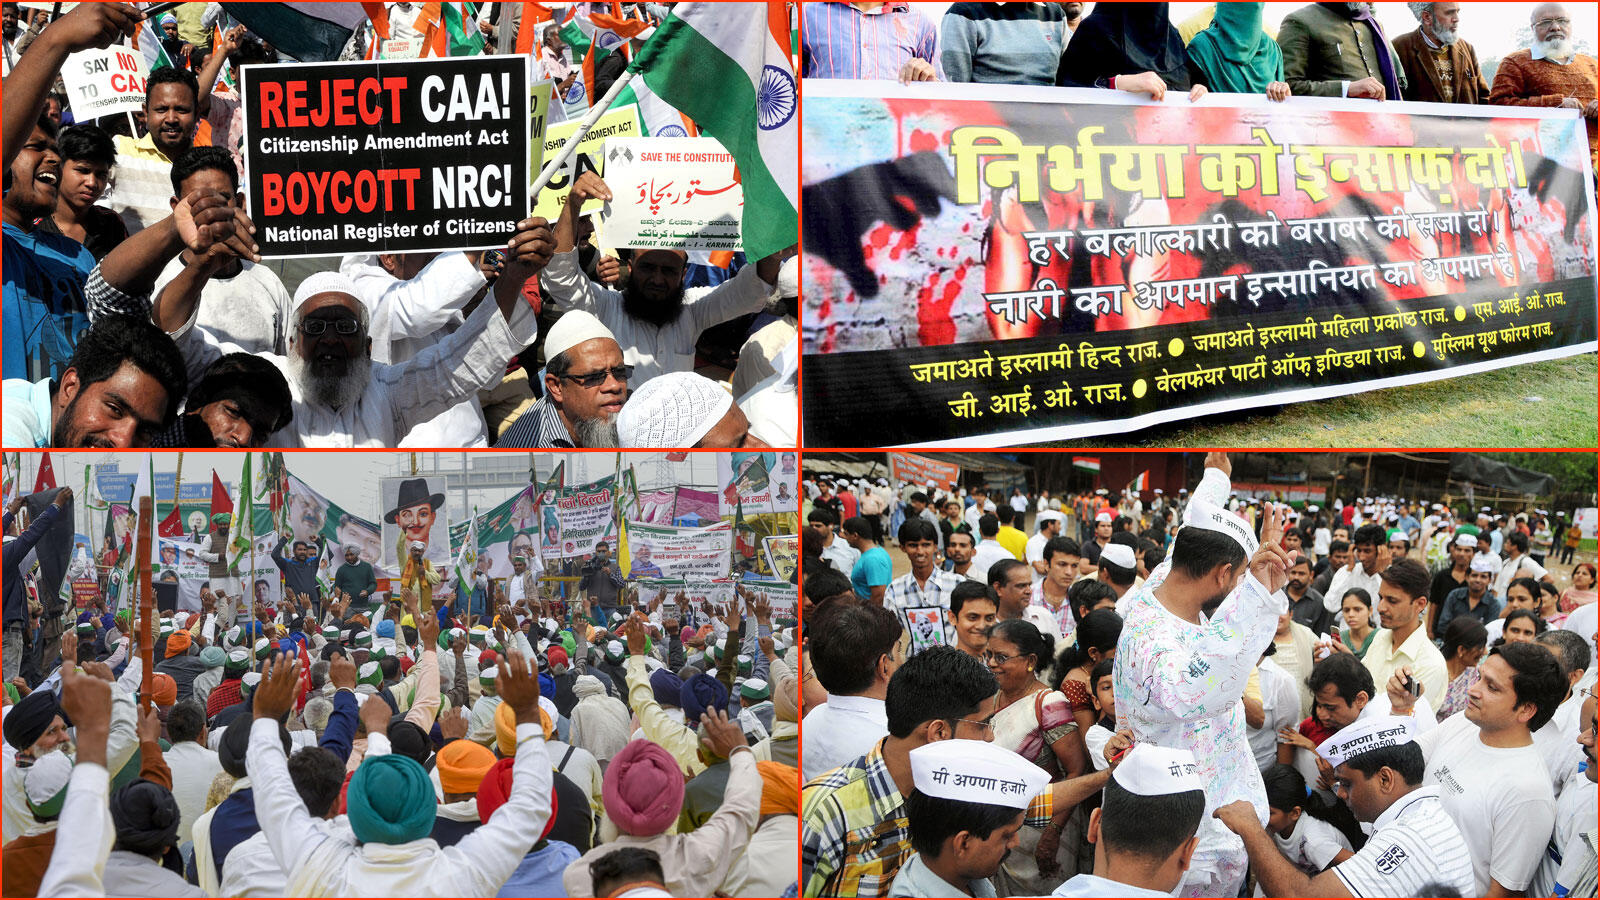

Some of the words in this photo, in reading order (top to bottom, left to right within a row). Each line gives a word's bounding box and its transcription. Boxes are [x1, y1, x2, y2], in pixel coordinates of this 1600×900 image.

[83, 57, 109, 75] SAY
[116, 52, 138, 72] NO
[79, 83, 98, 99] TO
[259, 77, 408, 128] REJECT
[420, 72, 510, 123] CAA!
[618, 121, 632, 133] ACT
[260, 134, 359, 154] Citizenship
[364, 131, 472, 150] Amendment
[477, 129, 509, 145] Act
[640, 152, 662, 162] SAVE
[665, 152, 681, 162] THE
[950, 125, 1188, 204] निर्भया
[1196, 126, 1284, 198] को
[262, 168, 421, 216] BOYCOTT
[432, 164, 512, 210] NRC!
[670, 179, 744, 206] ستور
[265, 225, 338, 242] National
[344, 222, 418, 242] Register
[423, 220, 442, 236] of
[446, 219, 516, 235] Citizens
[660, 240, 686, 248] ULAMA
[1021, 229, 1075, 266] हर
[1078, 213, 1234, 258] बलात्कारी
[1237, 210, 1280, 248] को
[1283, 214, 1376, 245] बराबर
[1374, 206, 1412, 240] की
[1410, 212, 1462, 238] सजा
[983, 278, 1066, 325] नारी
[1072, 284, 1128, 316] का
[1134, 273, 1239, 312] अपमान
[1248, 260, 1377, 307] इन्सानियत
[1380, 262, 1416, 288] का
[1420, 252, 1496, 281] अपमान
[910, 350, 994, 384] जमाअते
[998, 345, 1075, 381] इस्लामी
[1078, 342, 1122, 368] हिन्द
[1128, 340, 1163, 364] राज.
[1192, 322, 1254, 352] जमाअते
[1258, 316, 1318, 346] इस्लामी
[1320, 314, 1370, 338] महिला
[1372, 306, 1418, 332] प्रकोष्ठ
[1420, 307, 1450, 326] राज.
[1472, 302, 1496, 322] एस.
[1498, 292, 1524, 316] आई.
[1526, 290, 1544, 310] ओ.
[1544, 292, 1566, 308] राज.
[948, 392, 983, 419] जी.
[990, 389, 1037, 416] आई.
[1043, 381, 1078, 410] ओ.
[1084, 382, 1127, 405] राज.
[1155, 364, 1226, 394] वेलफेयर
[1230, 355, 1267, 382] पार्टी
[1314, 348, 1372, 376] इण्डिया
[1374, 345, 1406, 364] राज.
[1431, 332, 1476, 360] मुस्लिम
[1476, 331, 1498, 353] यूथ
[1499, 322, 1530, 343] फोरम
[1532, 322, 1554, 338] राज.
[1329, 744, 1339, 757] मी
[1340, 733, 1374, 752] अण्णा
[1376, 724, 1406, 740] हजारे
[932, 767, 951, 784] मी
[953, 774, 998, 790] अण्णा
[1000, 778, 1028, 796] हजारे
[1168, 760, 1183, 778] मी
